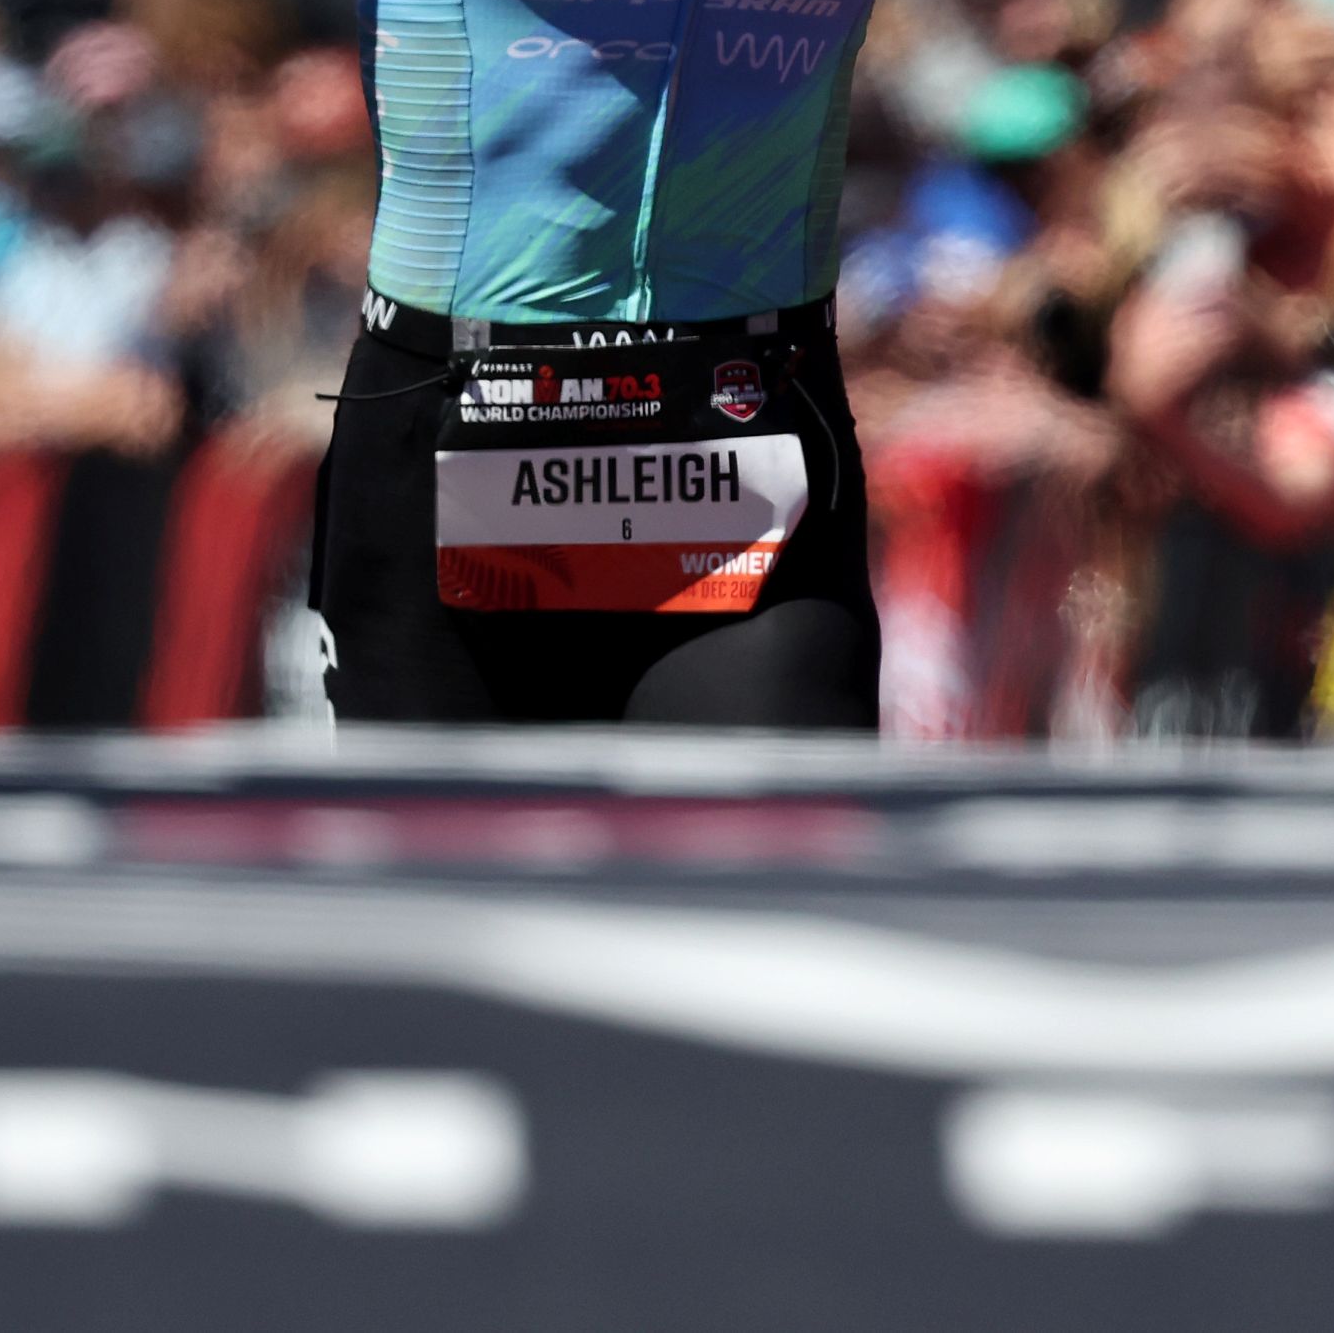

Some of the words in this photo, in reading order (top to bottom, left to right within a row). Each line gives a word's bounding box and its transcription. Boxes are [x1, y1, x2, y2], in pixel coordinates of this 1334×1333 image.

[605, 372, 663, 402] 70.3
[460, 404, 525, 423] WORLD
[526, 401, 663, 421] CHAMPIONSHIP
[512, 451, 740, 506] ASHLEIGH
[620, 517, 633, 541] 6
[701, 580, 727, 599] DEC
[730, 580, 759, 599] 202
